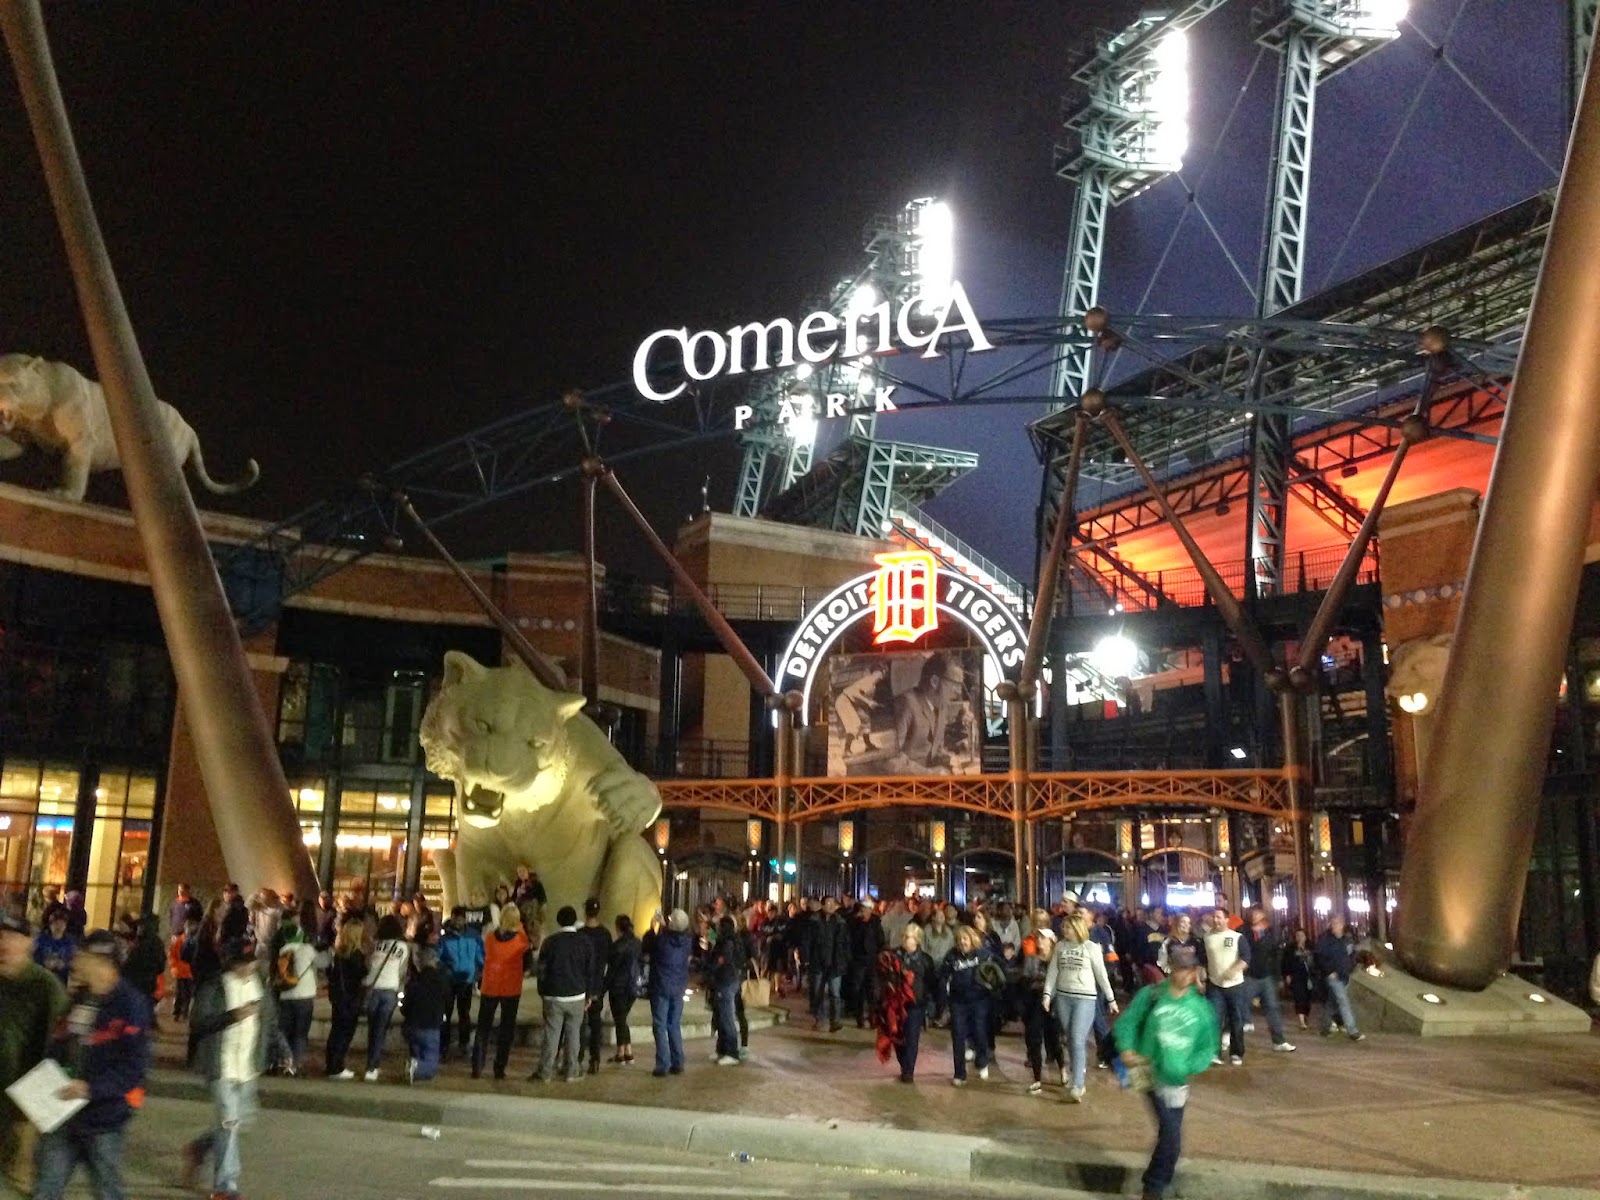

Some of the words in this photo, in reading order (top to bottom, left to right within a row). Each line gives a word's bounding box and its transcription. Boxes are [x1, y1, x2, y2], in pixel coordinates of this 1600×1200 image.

[734, 385, 898, 430] PARK
[786, 582, 869, 678] DETROIT
[945, 581, 1024, 667] TIGERS
[1182, 857, 1204, 878] 1980
